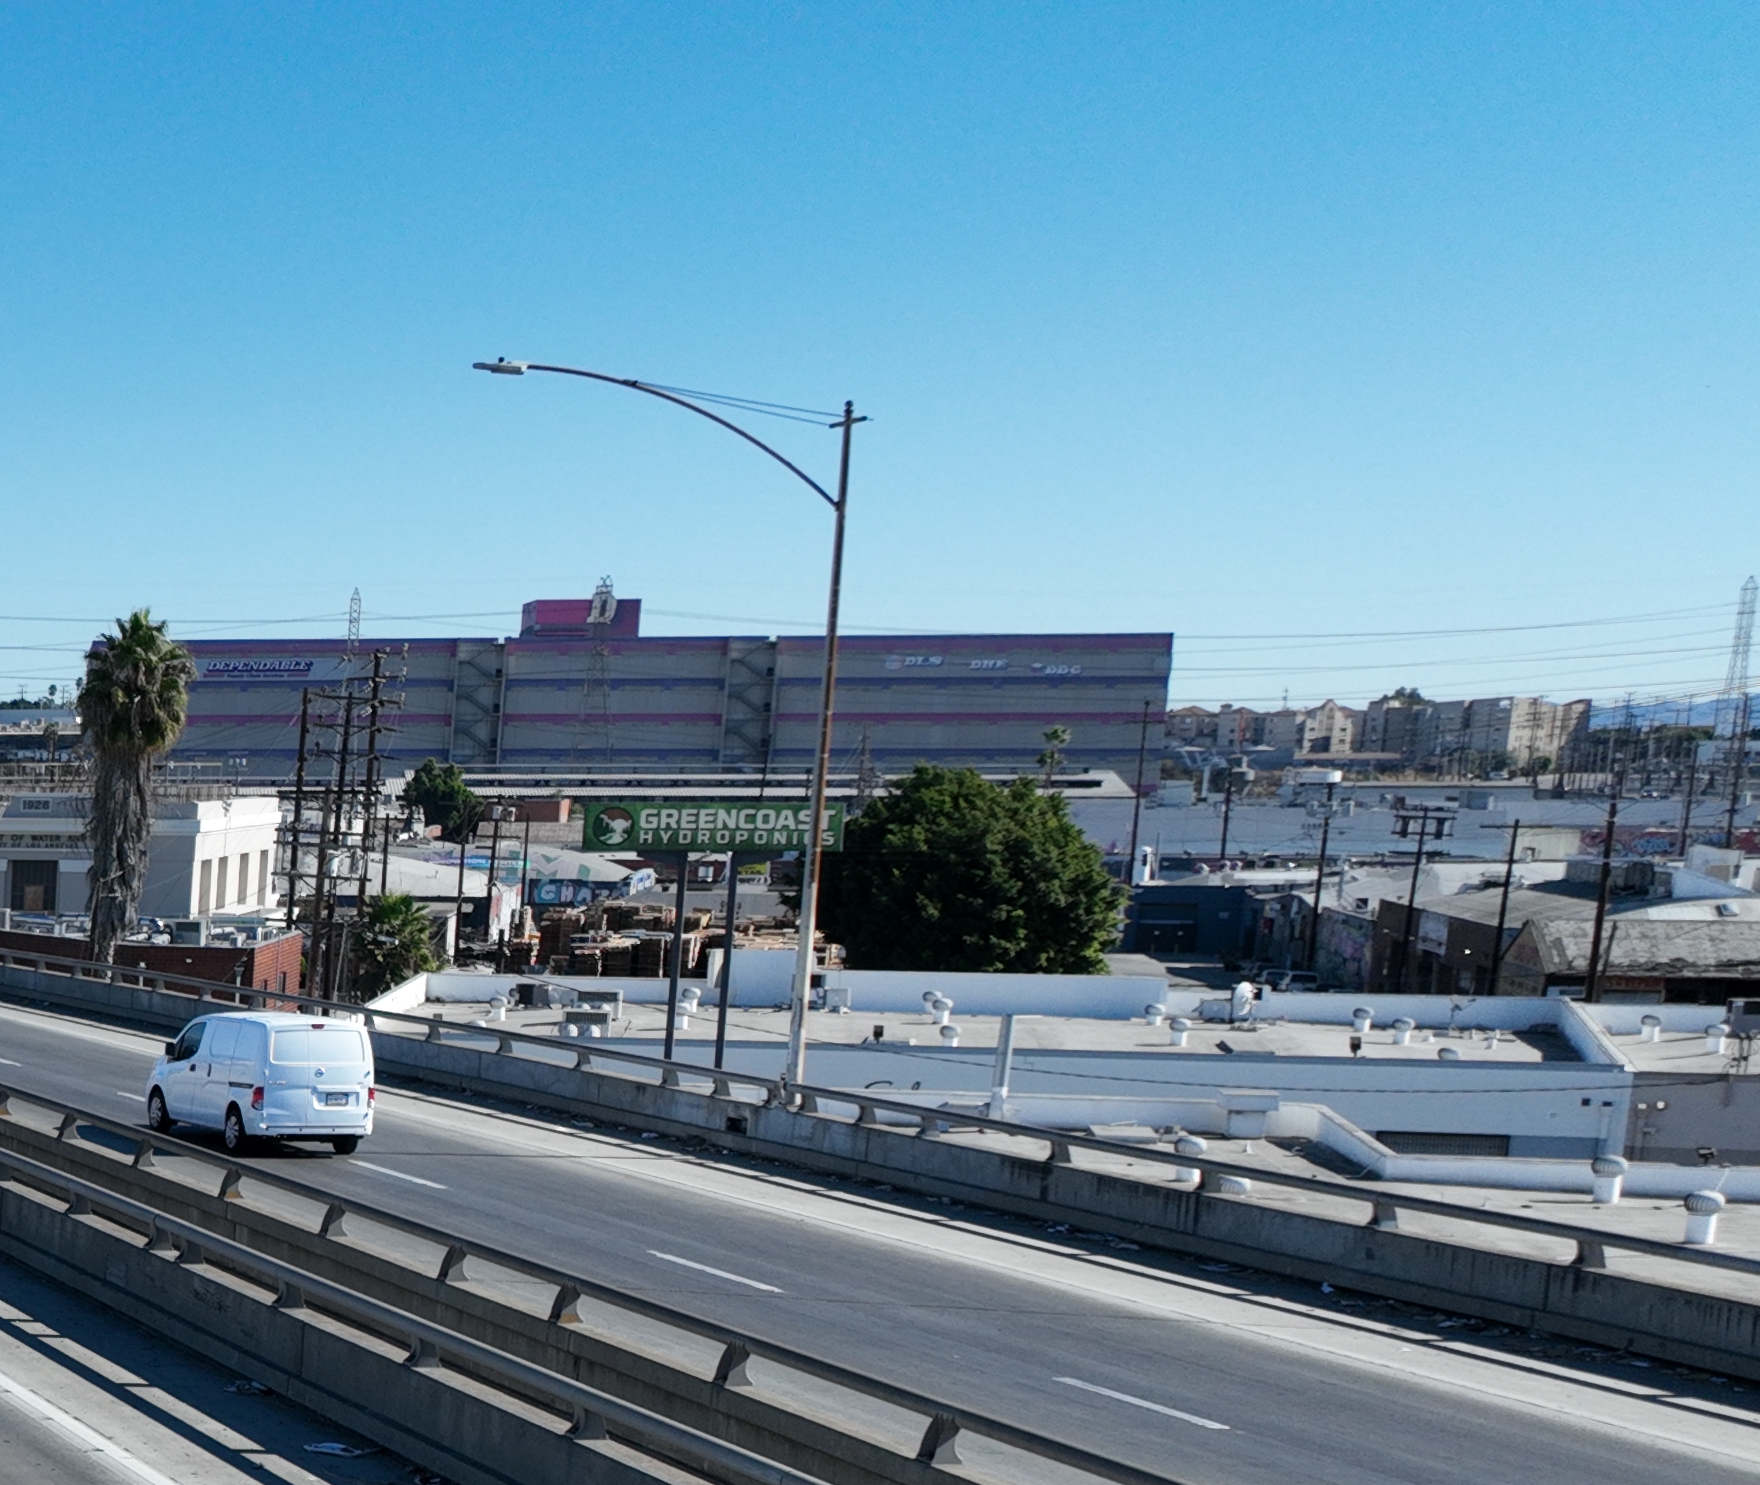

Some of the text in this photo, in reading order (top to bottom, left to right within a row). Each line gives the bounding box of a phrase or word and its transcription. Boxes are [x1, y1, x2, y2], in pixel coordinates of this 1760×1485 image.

[207, 660, 313, 672] DEPENDABLE
[23, 800, 50, 811] 1926
[639, 808, 836, 830] GREENCOAST
[11, 834, 25, 842] OF
[31, 834, 61, 842] WATER
